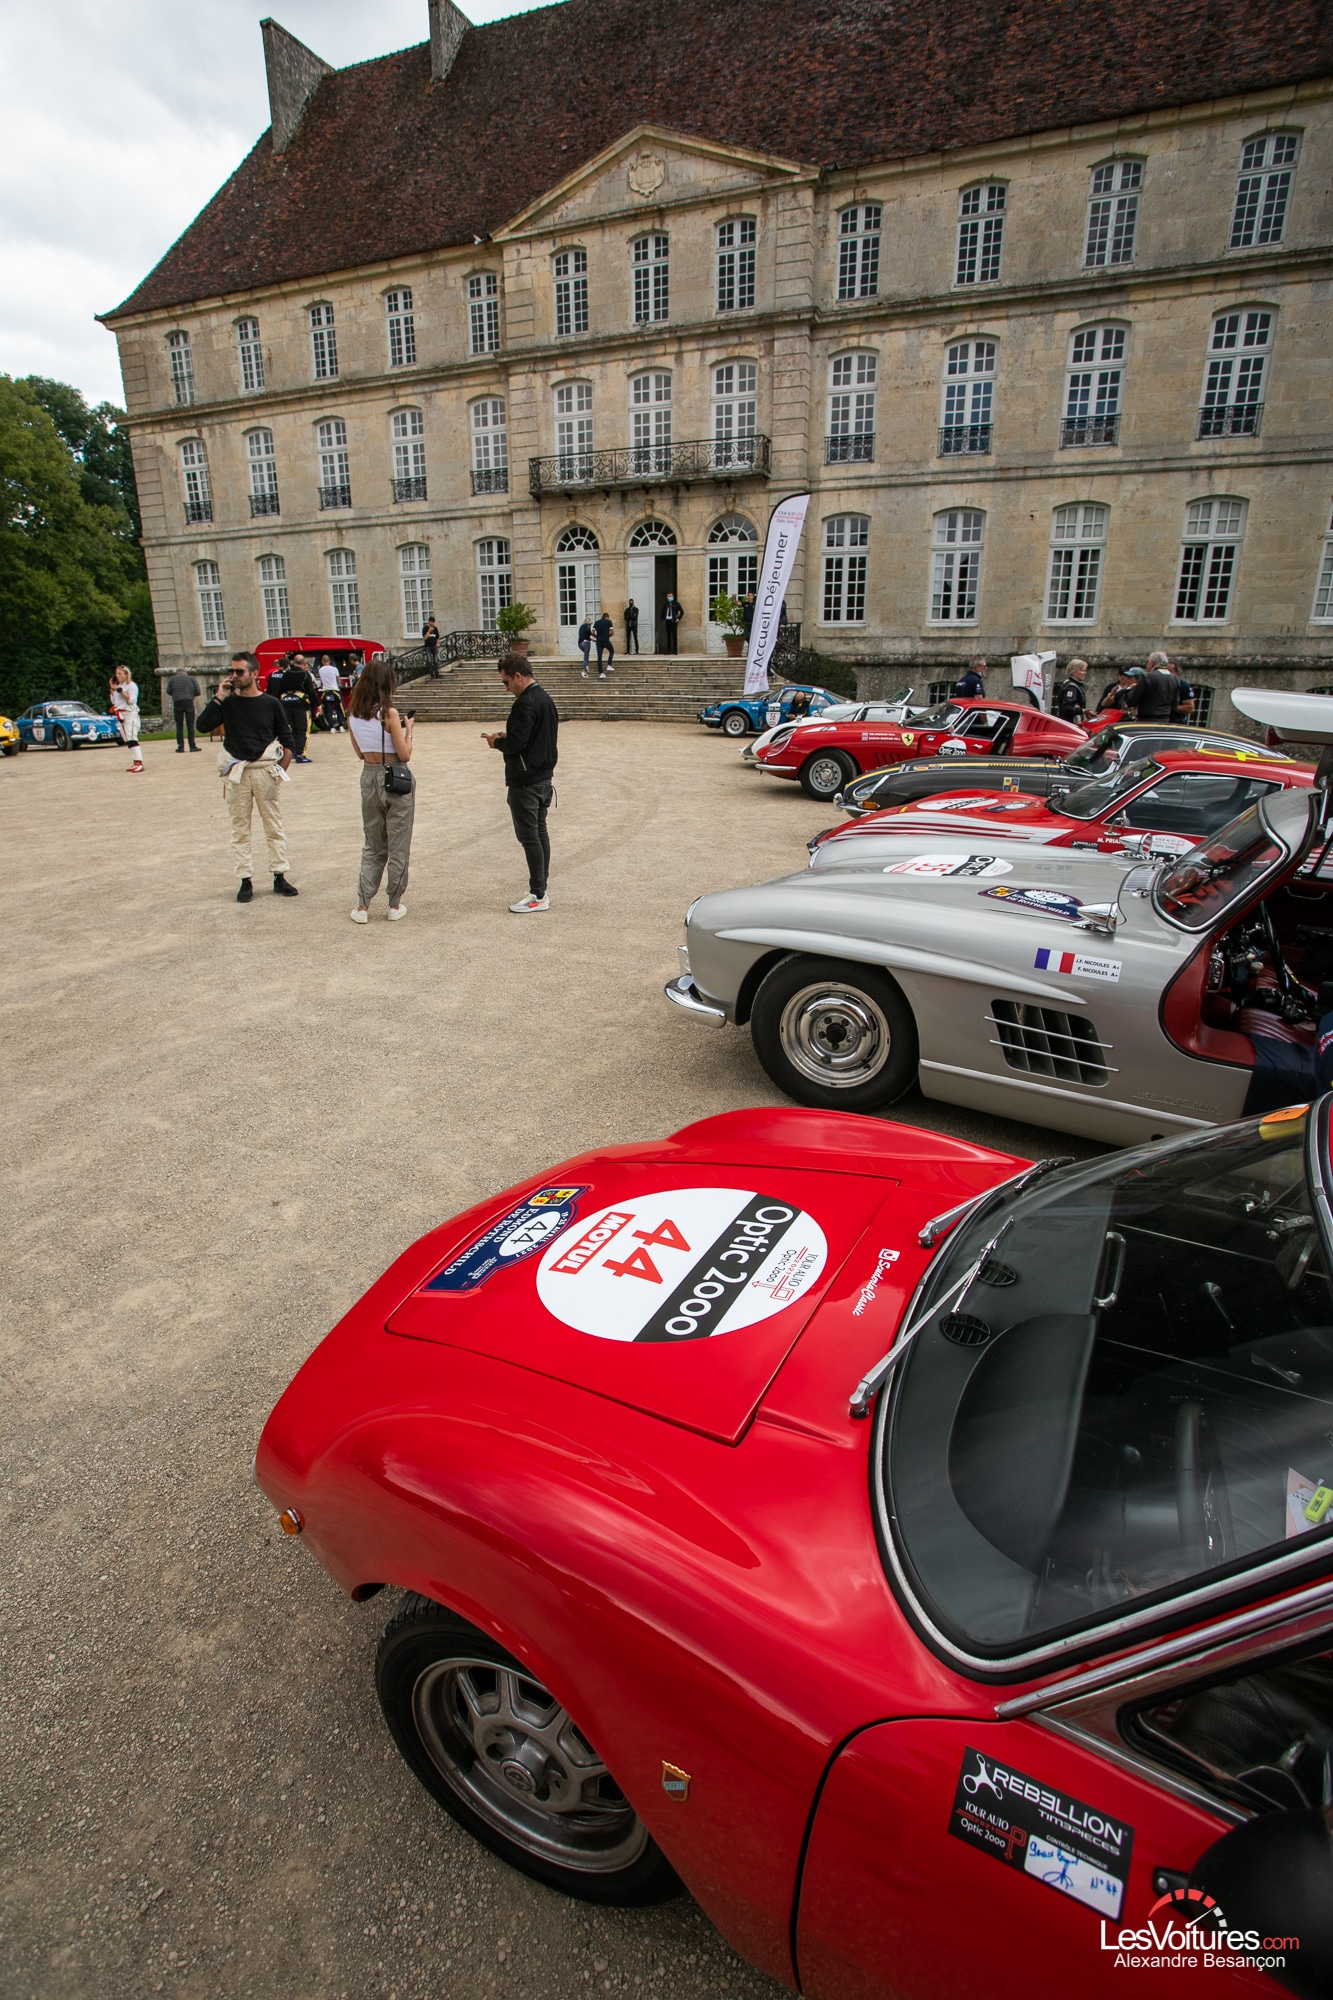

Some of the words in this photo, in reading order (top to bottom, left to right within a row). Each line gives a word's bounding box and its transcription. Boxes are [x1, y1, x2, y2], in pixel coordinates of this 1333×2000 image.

[753, 611, 772, 668] Accueil
[764, 531, 789, 607] Déjeuner
[939, 746, 953, 756] Optic
[493, 1208, 540, 1243] EDMOND
[508, 1208, 526, 1219] DE
[444, 1217, 514, 1275] ROTHSCHILD
[510, 1221, 548, 1245] 44
[557, 1214, 627, 1270] MOTUL
[719, 1205, 794, 1264] Optic
[602, 1218, 692, 1285] 44
[778, 1249, 797, 1266] Optic
[786, 1259, 800, 1275] 2021
[800, 1253, 819, 1270] TOUR
[788, 1269, 806, 1287] AUTO
[664, 1266, 748, 1335] 2000
[965, 1800, 987, 1820] TOUR
[986, 1813, 1009, 1831] AUTO
[992, 1767, 1123, 1846] REBELLION
[961, 1817, 984, 1836] Optic
[984, 1830, 1006, 1848] 2000
[1038, 1808, 1120, 1857] TIMEPIECES
[1046, 1834, 1076, 1854] CONTRÔLE
[1076, 1849, 1108, 1871] TECHNIQUE
